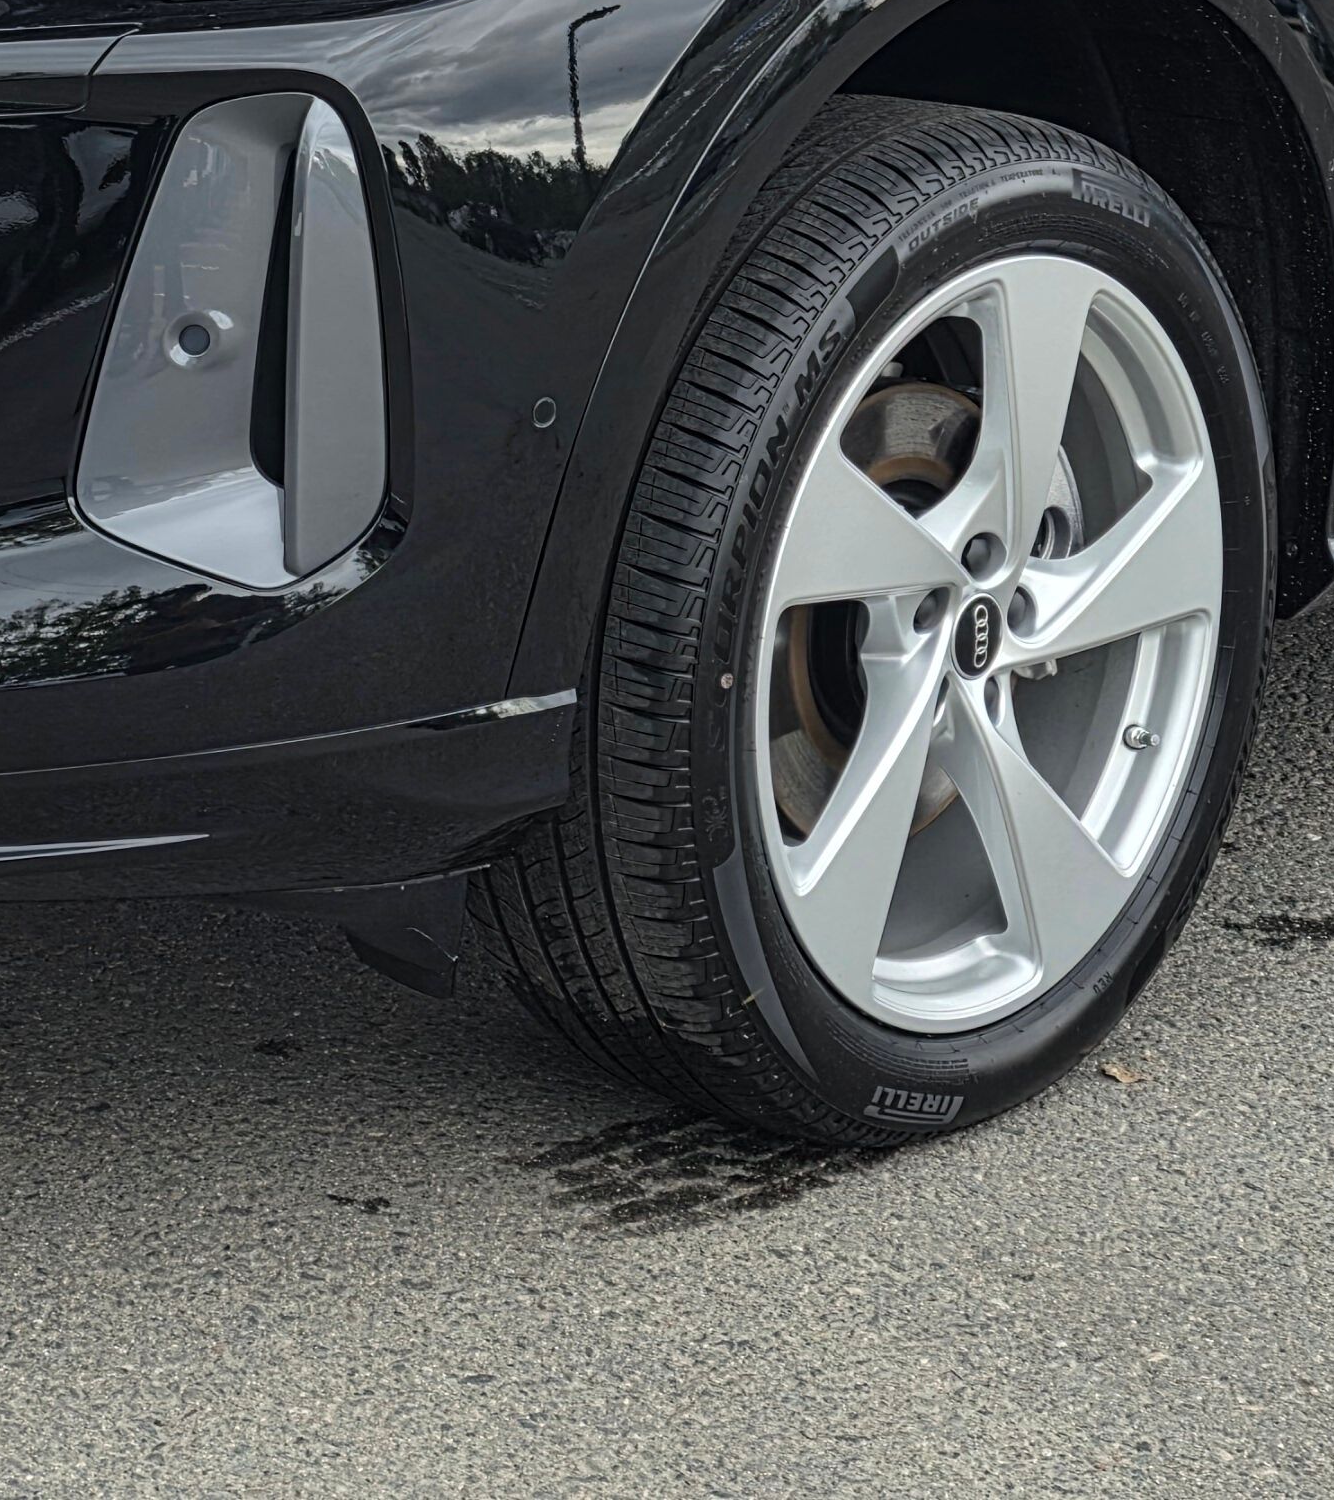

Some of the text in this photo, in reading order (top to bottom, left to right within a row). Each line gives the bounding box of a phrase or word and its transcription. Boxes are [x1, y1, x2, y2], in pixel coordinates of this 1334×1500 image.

[908, 197, 980, 252] OUTSIDE
[1071, 167, 1151, 228] PIRELLI
[795, 319, 841, 408] MS
[863, 1085, 964, 1125] PIRELLI
